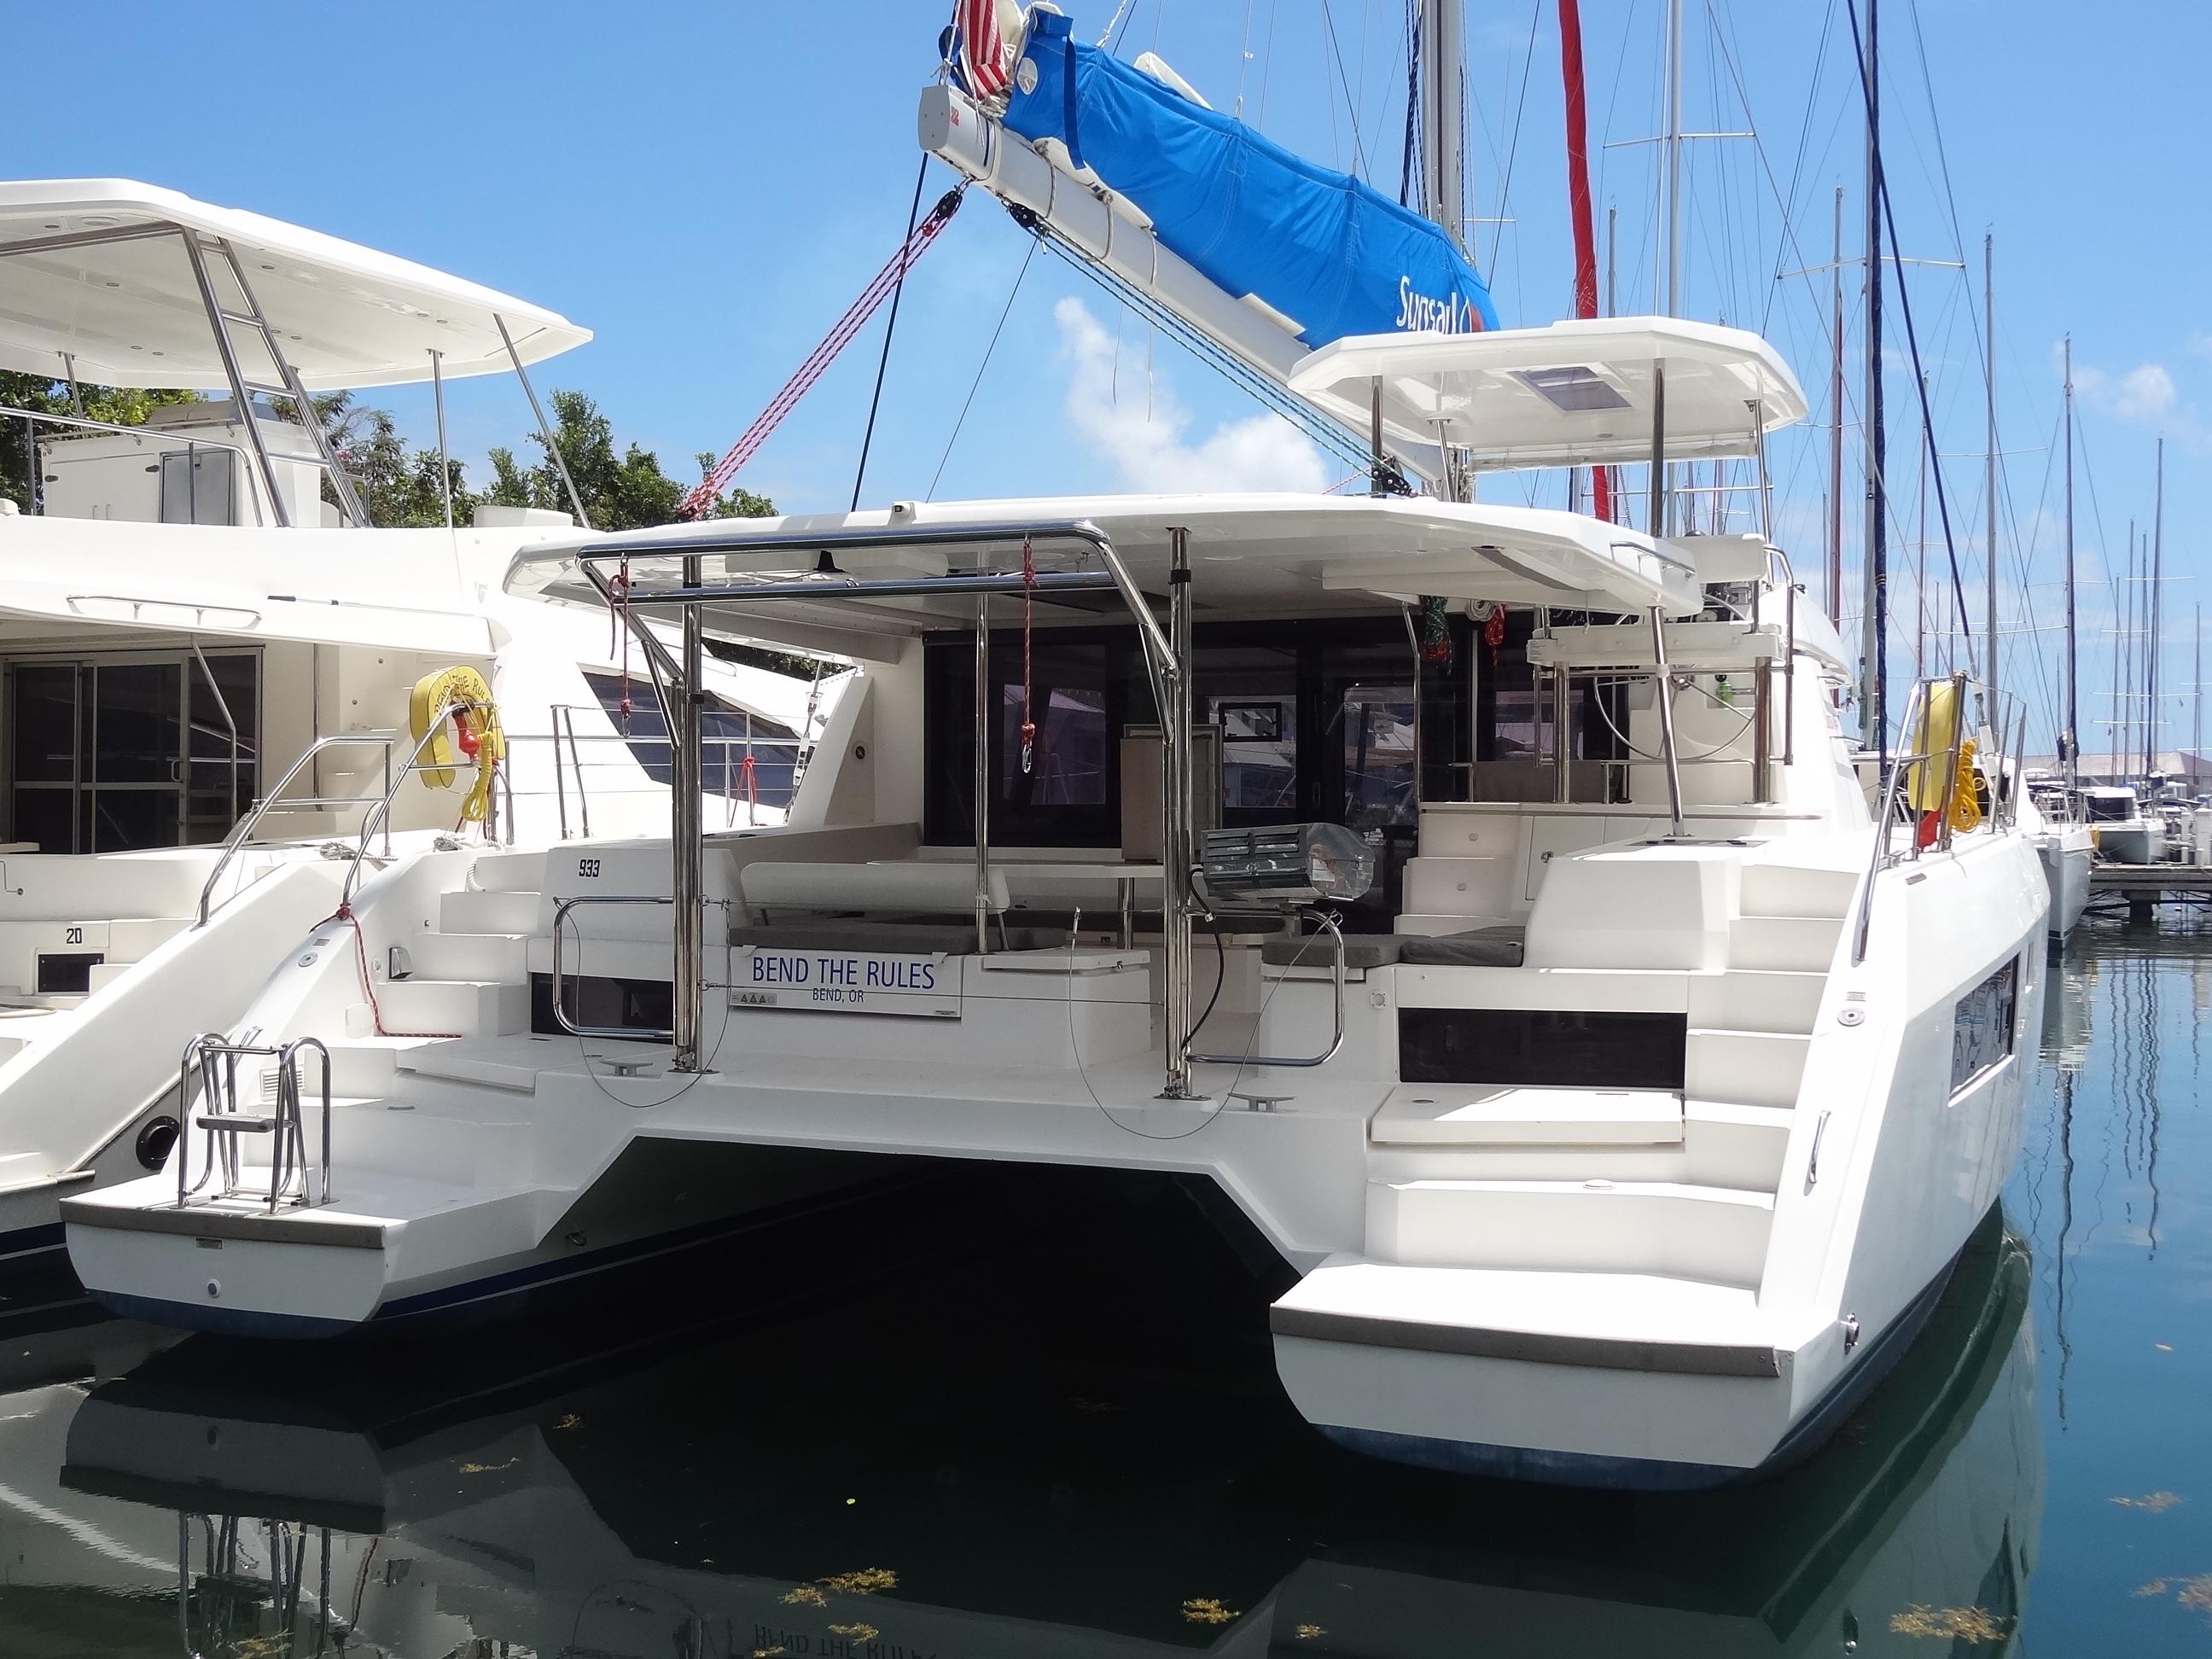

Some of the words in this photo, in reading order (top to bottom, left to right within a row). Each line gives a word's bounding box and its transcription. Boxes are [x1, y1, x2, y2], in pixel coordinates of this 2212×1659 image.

[1396, 275, 1457, 335] Sunsail
[472, 678, 491, 703] RUL
[579, 859, 601, 878] 933
[66, 927, 83, 944] 20
[753, 956, 809, 982] BEND
[817, 958, 858, 985] THE
[867, 960, 935, 990] RULES
[812, 988, 845, 1004] BEND,
[848, 989, 864, 1003] OR
